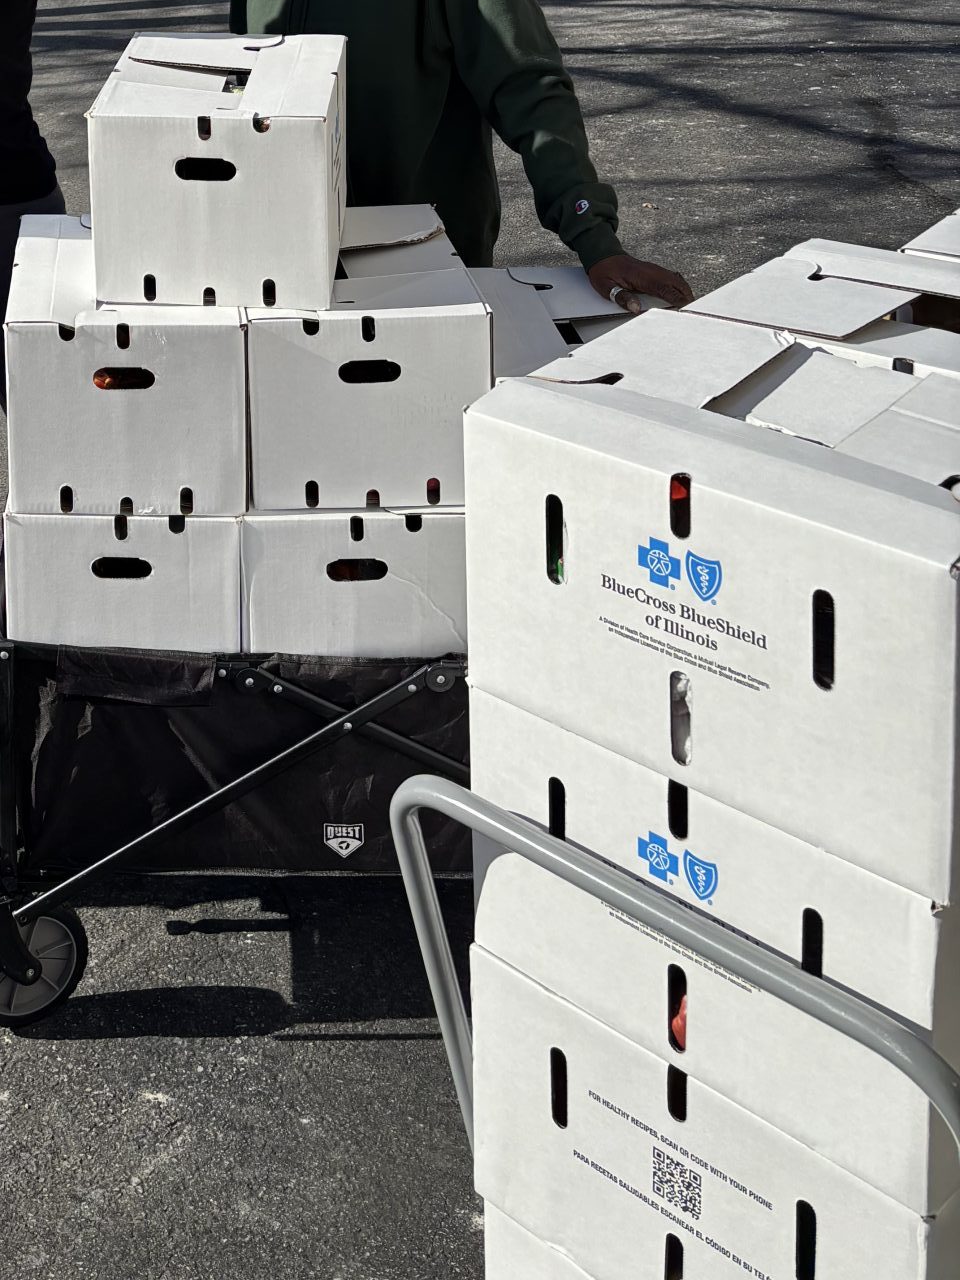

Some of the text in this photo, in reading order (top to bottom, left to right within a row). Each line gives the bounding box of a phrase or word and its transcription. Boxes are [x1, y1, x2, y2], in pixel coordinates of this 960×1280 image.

[601, 573, 768, 651] BlueCross BlueShield
[614, 629, 639, 644] Independent
[645, 614, 718, 651] of Illinois
[603, 617, 619, 628] Division
[715, 661, 727, 671] Legal
[327, 826, 360, 839] QUEST
[588, 1089, 774, 1212] FOR HEALTHY RECIPES, SCAN QR CODE WITH YOUR PHONE
[573, 1149, 590, 1166] PARA
[590, 1160, 618, 1184] RECETAS
[618, 1178, 660, 1211] SALUDABLES
[660, 1206, 695, 1236] ESCANEAR
[695, 1229, 705, 1241] EL
[705, 1236, 732, 1260] CÓDIGO
[731, 1253, 742, 1267] EN
[742, 1260, 754, 1274] SU
